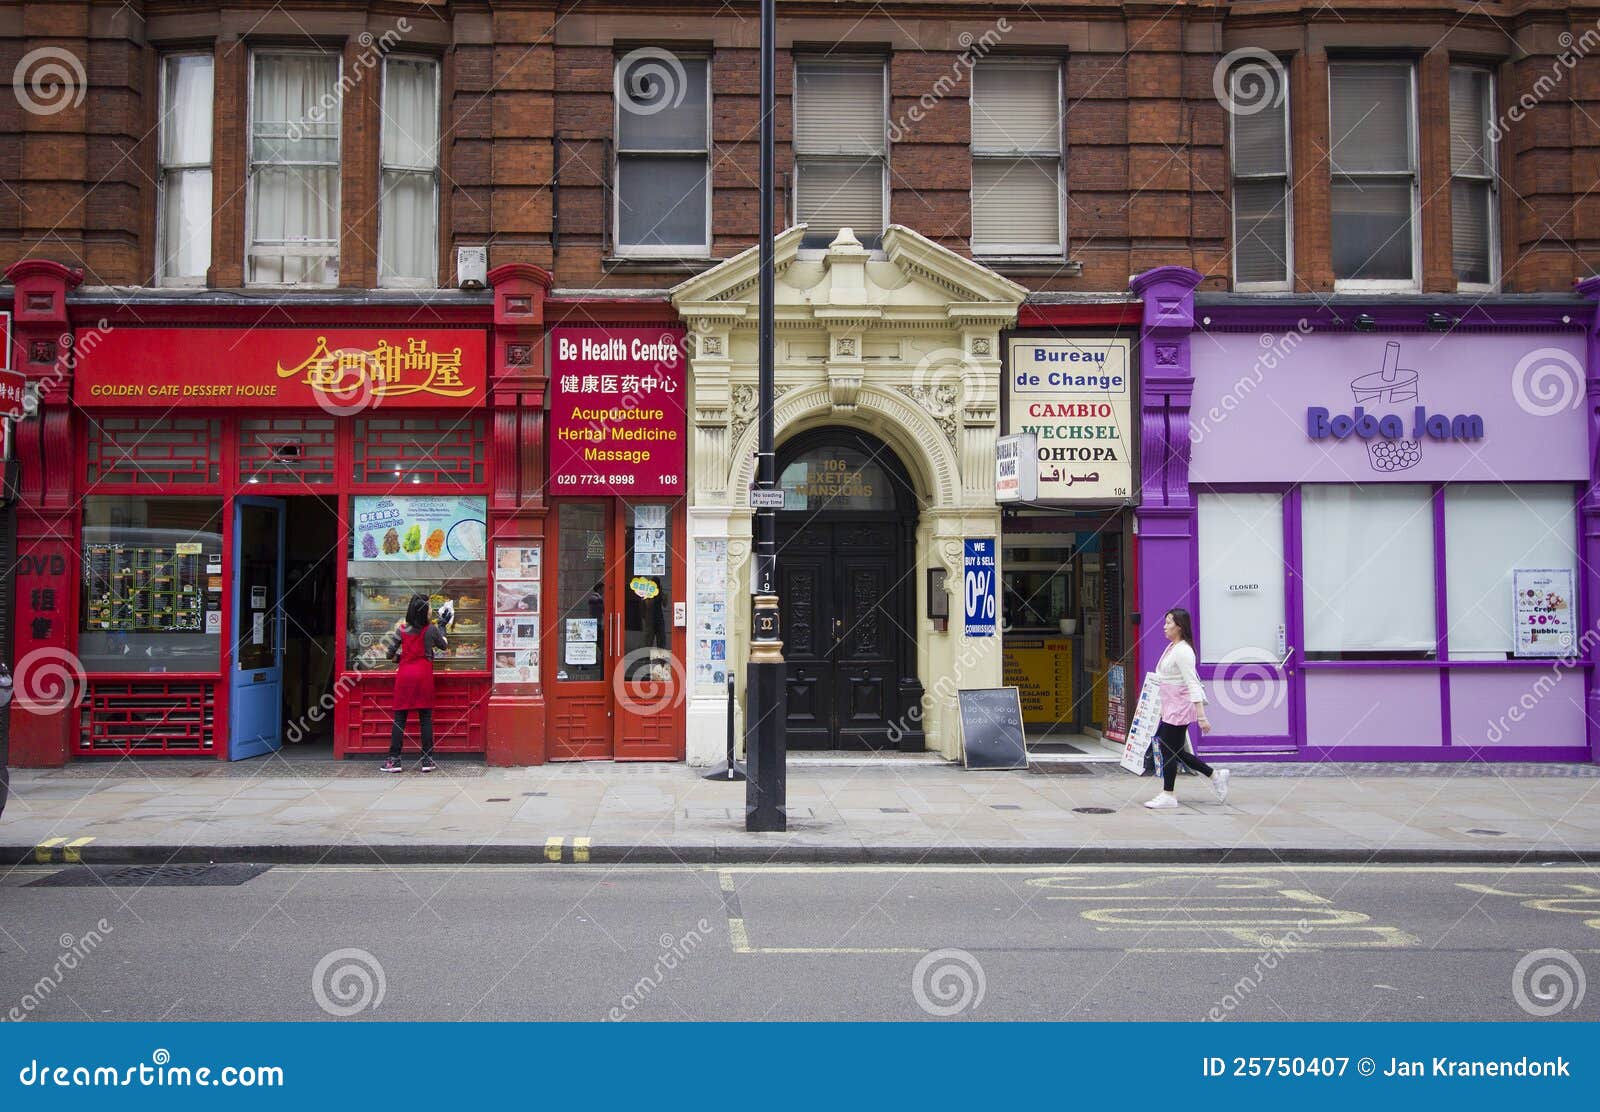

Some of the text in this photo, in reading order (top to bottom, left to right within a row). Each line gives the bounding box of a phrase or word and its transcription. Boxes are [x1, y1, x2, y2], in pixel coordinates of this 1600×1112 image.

[559, 338, 678, 361] Be Health Centre
[1034, 348, 1105, 362] Bureau
[276, 336, 476, 397] 金門甜品屋
[560, 374, 678, 394] 健康医药中心
[1016, 372, 1123, 389] de Change
[91, 384, 277, 396] GOLDEN GATE DESSERT HOUSE
[571, 406, 664, 423] Acupuncture
[1029, 403, 1112, 418] CAMBIO
[1307, 405, 1484, 439] Boba Jam
[558, 427, 677, 441] Herbal Medicine
[1021, 425, 1120, 440] WECHSEL
[584, 448, 651, 464] Massage
[1037, 447, 1118, 461] ОНТОРА
[823, 459, 847, 470] 106
[557, 474, 678, 485] 020 7734 8998 108
[807, 472, 864, 484] EXETER
[796, 484, 873, 497] MANSIONS
[1113, 487, 1126, 496] 104
[974, 543, 985, 551] WE
[17, 555, 65, 576] DVD
[965, 557, 975, 566] BUY
[982, 557, 994, 566] SELL
[965, 571, 995, 619] 0%
[1528, 615, 1560, 625] 50%
[965, 625, 995, 633] COMMISSION
